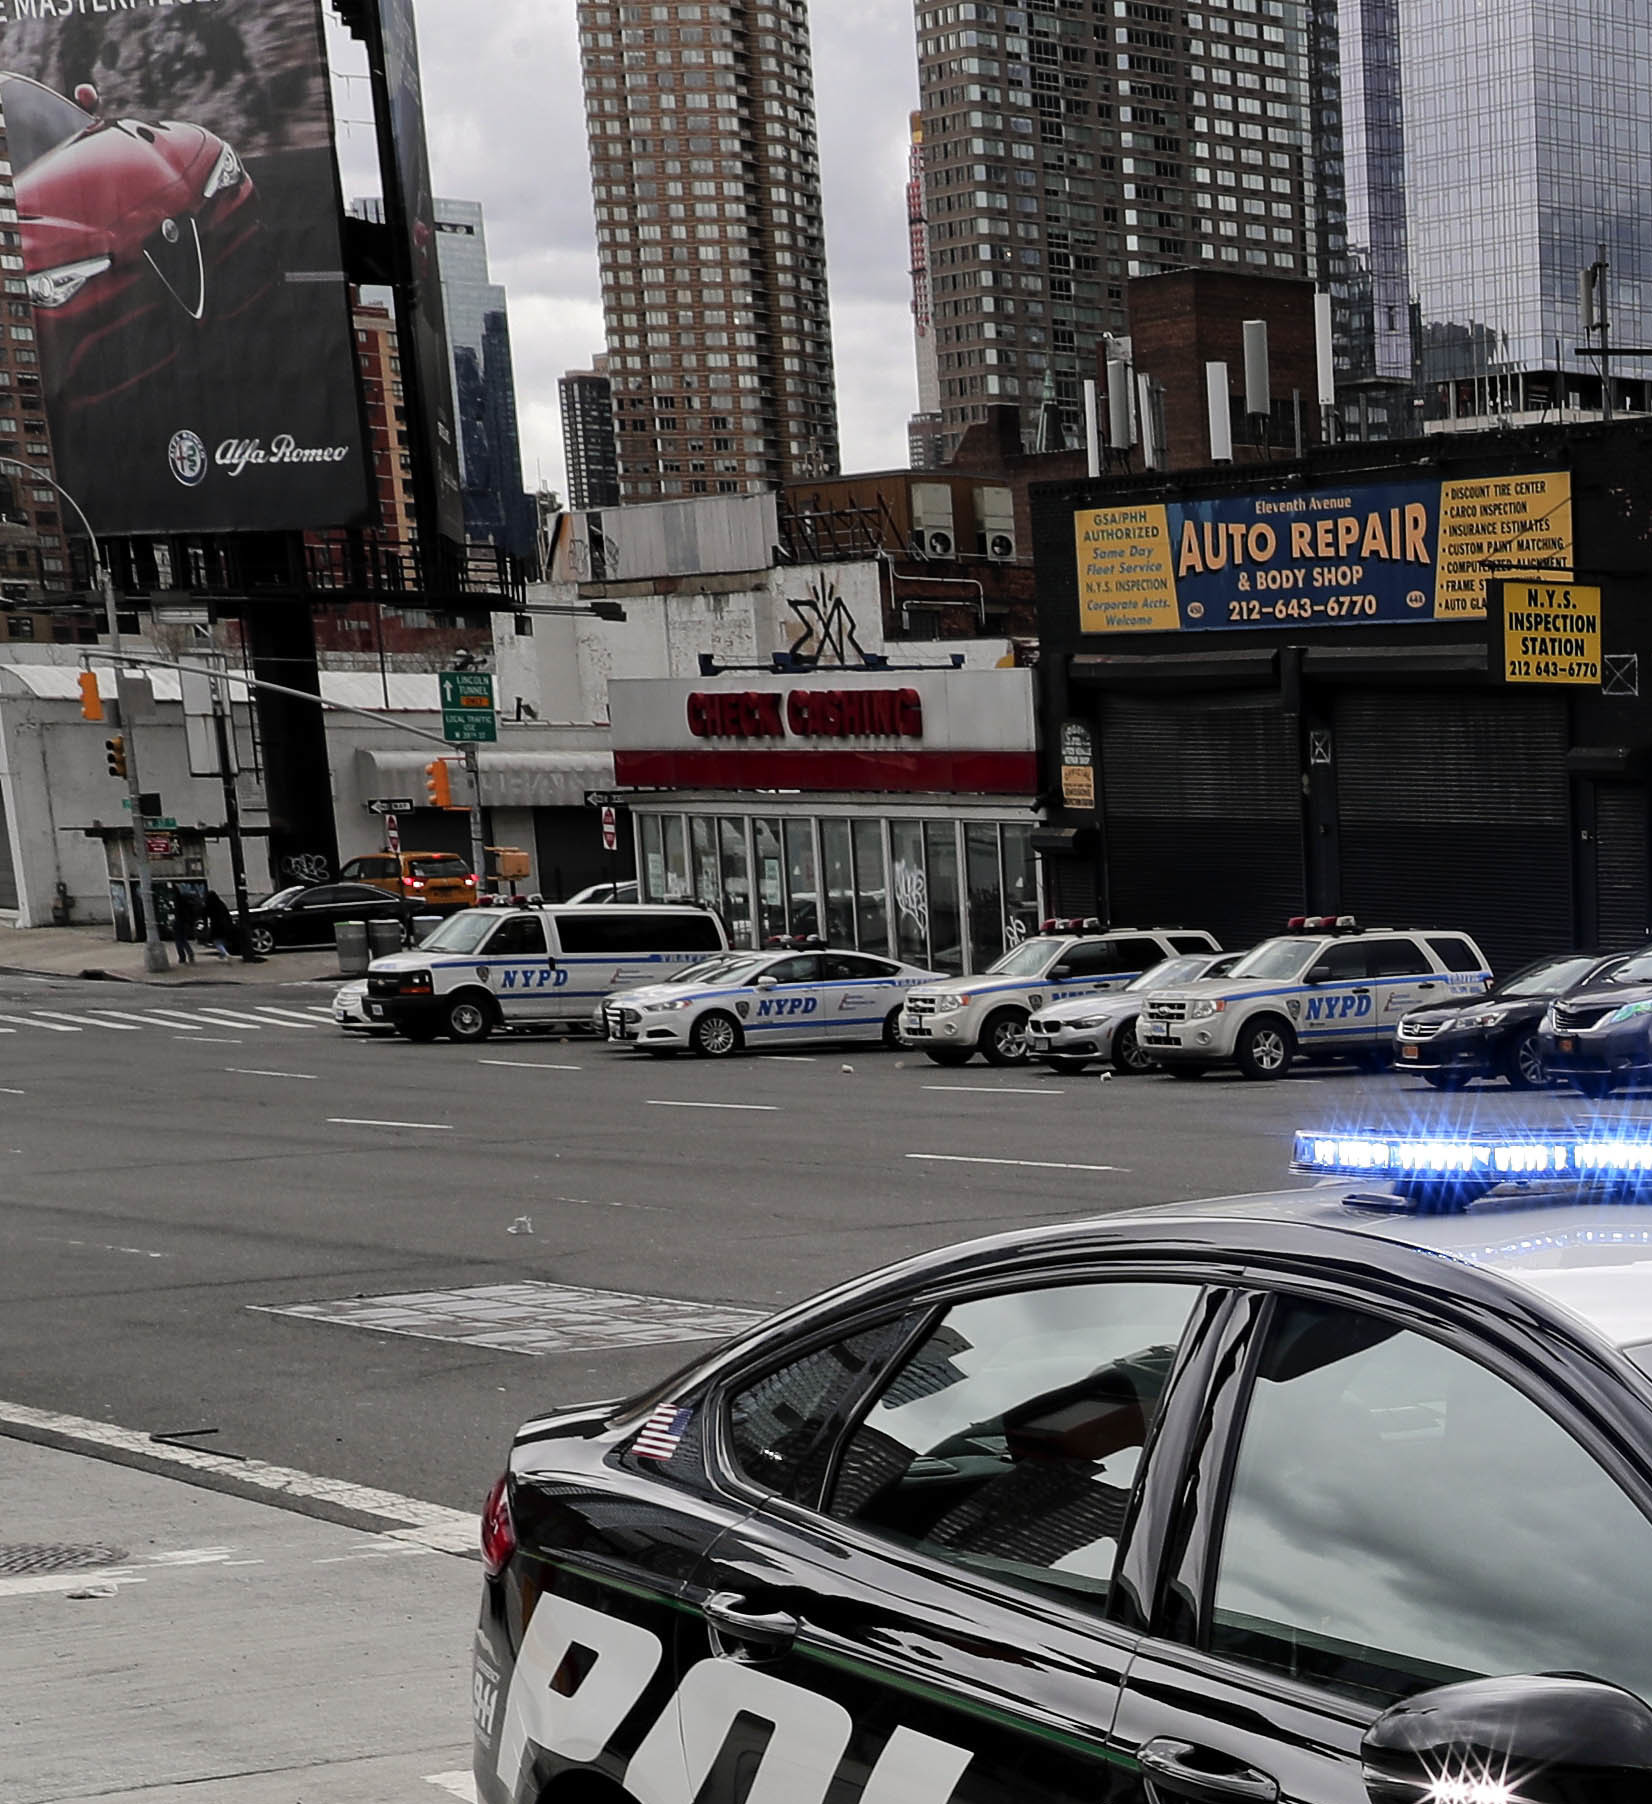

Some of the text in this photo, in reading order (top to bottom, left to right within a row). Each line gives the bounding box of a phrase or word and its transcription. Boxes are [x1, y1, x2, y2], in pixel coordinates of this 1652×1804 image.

[215, 439, 267, 476] Alfa
[268, 434, 348, 463] Romeo
[1451, 481, 1546, 500] DISCOUNT TIRE CENTER
[1255, 497, 1352, 515] Eleventh Avenue
[1450, 501, 1528, 519] CARCO INSPECTION
[1094, 511, 1147, 526] GSA/PHH
[1448, 518, 1550, 537] INSURANCE ESTIMATES
[1084, 526, 1159, 541] AUTHORIZED
[1178, 502, 1431, 577] AUTO REPAIR
[1093, 545, 1154, 560] Same Day
[1448, 537, 1565, 556] CUSTOM PAINT MATCHING
[1087, 561, 1162, 575] Fleet Service
[1086, 578, 1168, 593] N.Y.S. INSPECTION
[1238, 565, 1364, 591] & BODY SHOP
[1446, 580, 1475, 592] FRAME
[1087, 599, 1138, 612] Corporate
[1228, 594, 1377, 620] 212-643-6770
[1444, 597, 1487, 611] AUTO GLA
[1528, 589, 1577, 609] N.Y.S.
[1106, 614, 1153, 626] Welcome
[1509, 612, 1597, 634] INSPECTION
[1521, 637, 1585, 657] STATION
[1510, 660, 1598, 678] 212 643-6770
[456, 675, 489, 685] LINCOLN
[459, 685, 489, 695] TUNNEL
[687, 688, 924, 738] CHECK CASHING
[501, 969, 569, 988] NYPD
[756, 997, 818, 1017] NYPD
[1305, 993, 1372, 1020] NYPD
